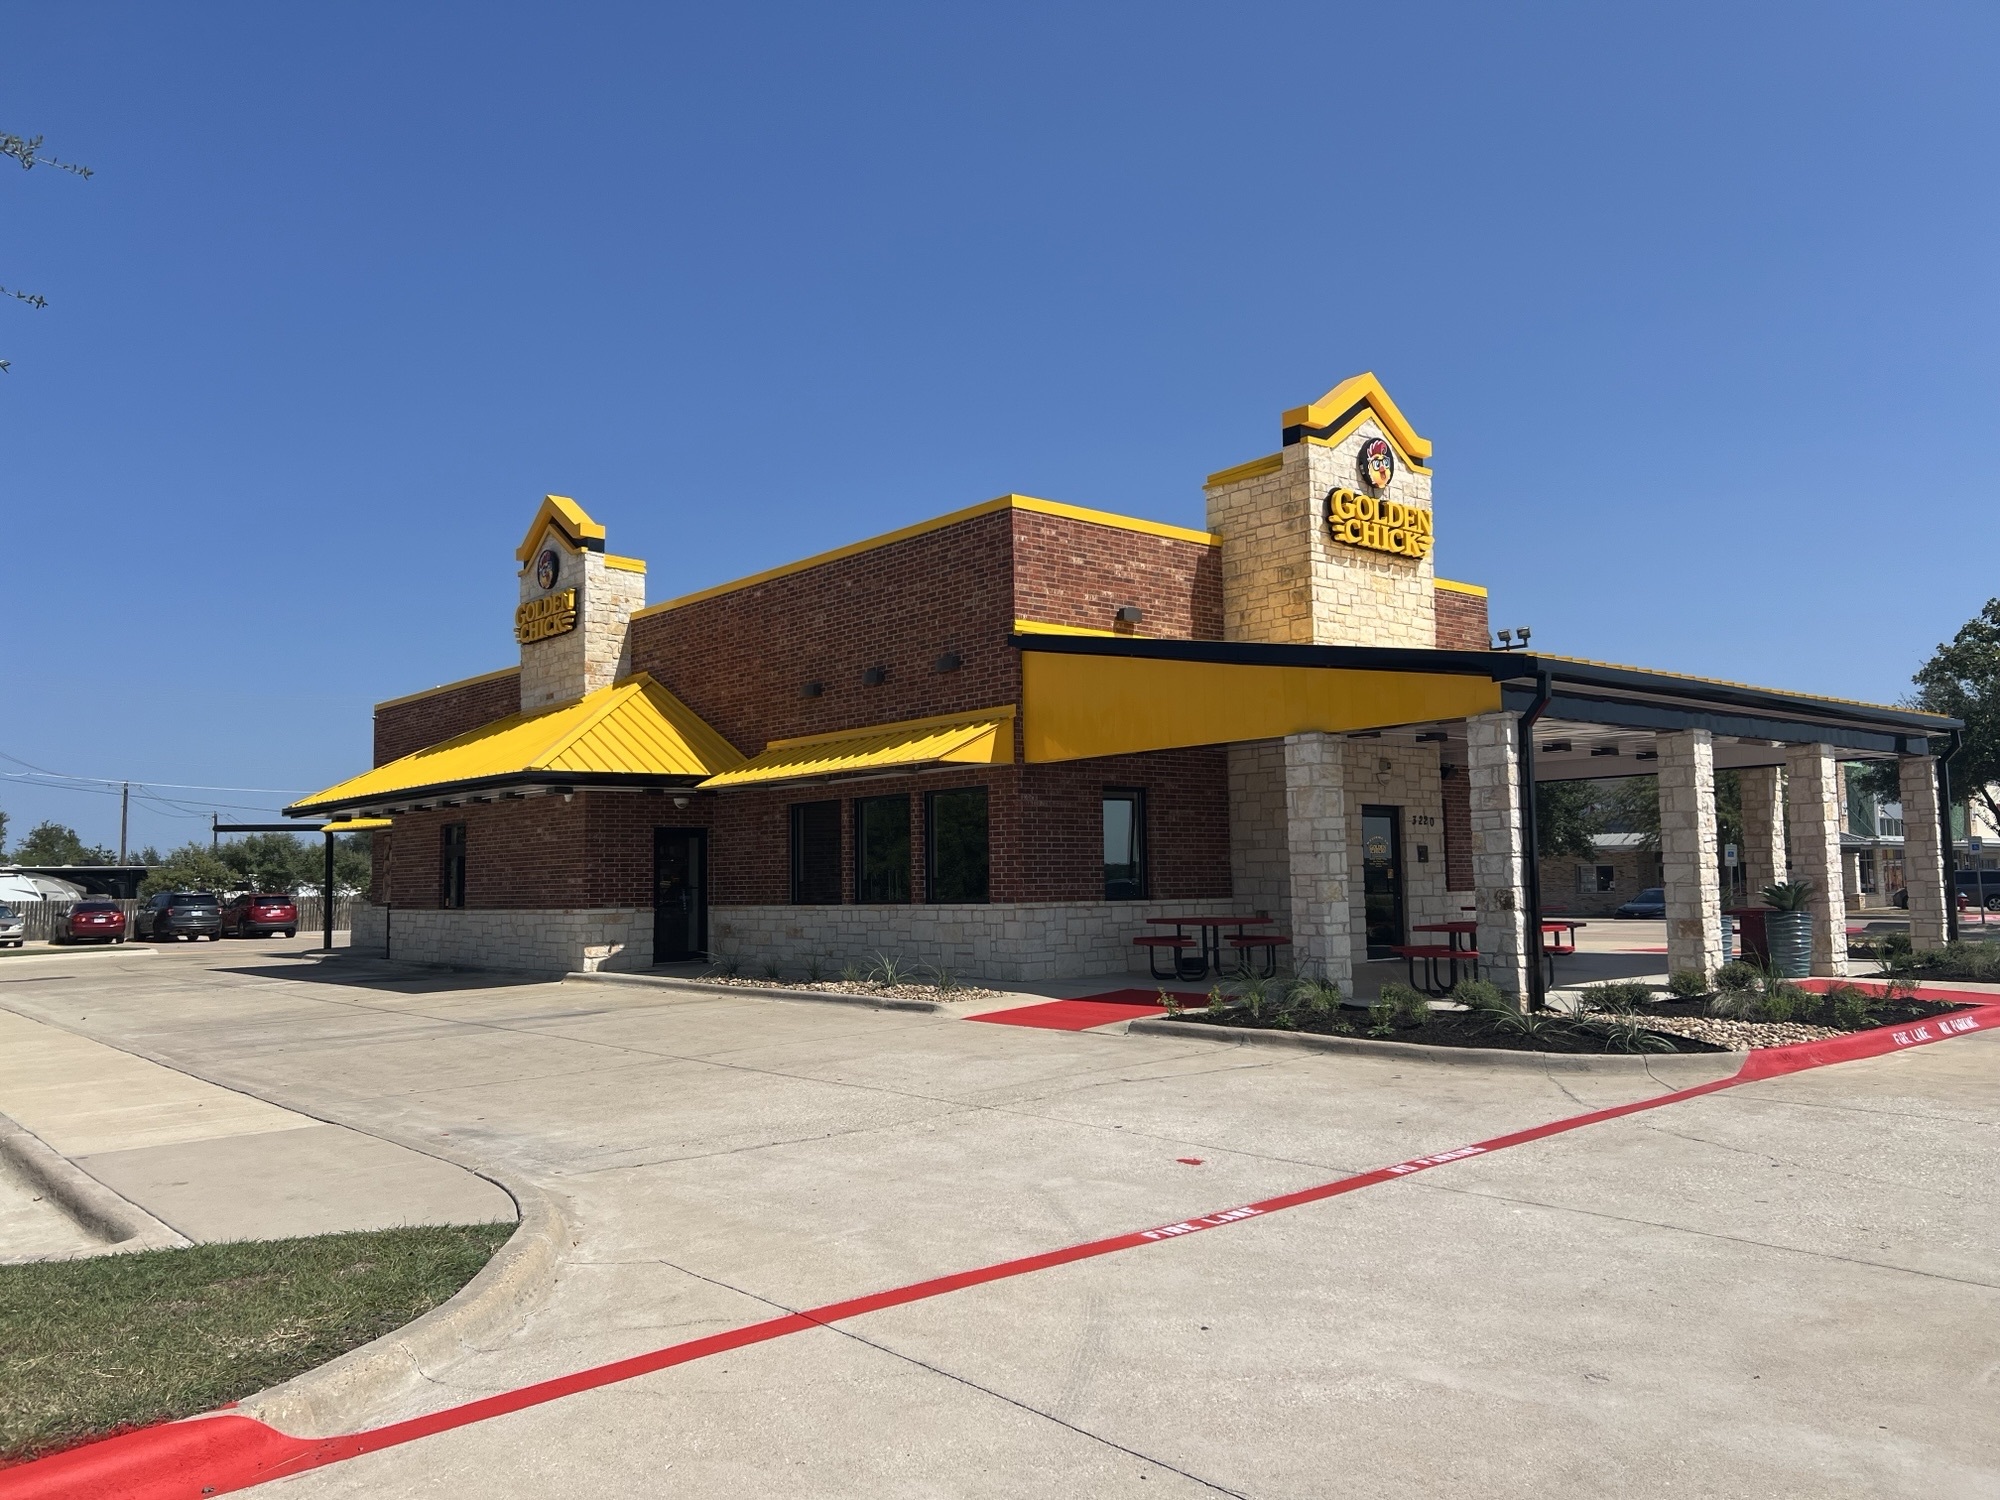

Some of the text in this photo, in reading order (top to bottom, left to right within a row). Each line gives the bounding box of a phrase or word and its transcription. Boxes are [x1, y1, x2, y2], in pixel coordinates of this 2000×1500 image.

[1331, 488, 1433, 535] GOLDEN
[1345, 518, 1425, 558] CHICK
[515, 588, 576, 627] GOLDEN
[520, 611, 568, 644] CHICK
[1411, 815, 1435, 828] 3220
[1892, 1015, 1980, 1046] FIRE LANE NO PARKING
[1141, 1146, 1487, 1240] FIRE LANE NO PARKING
